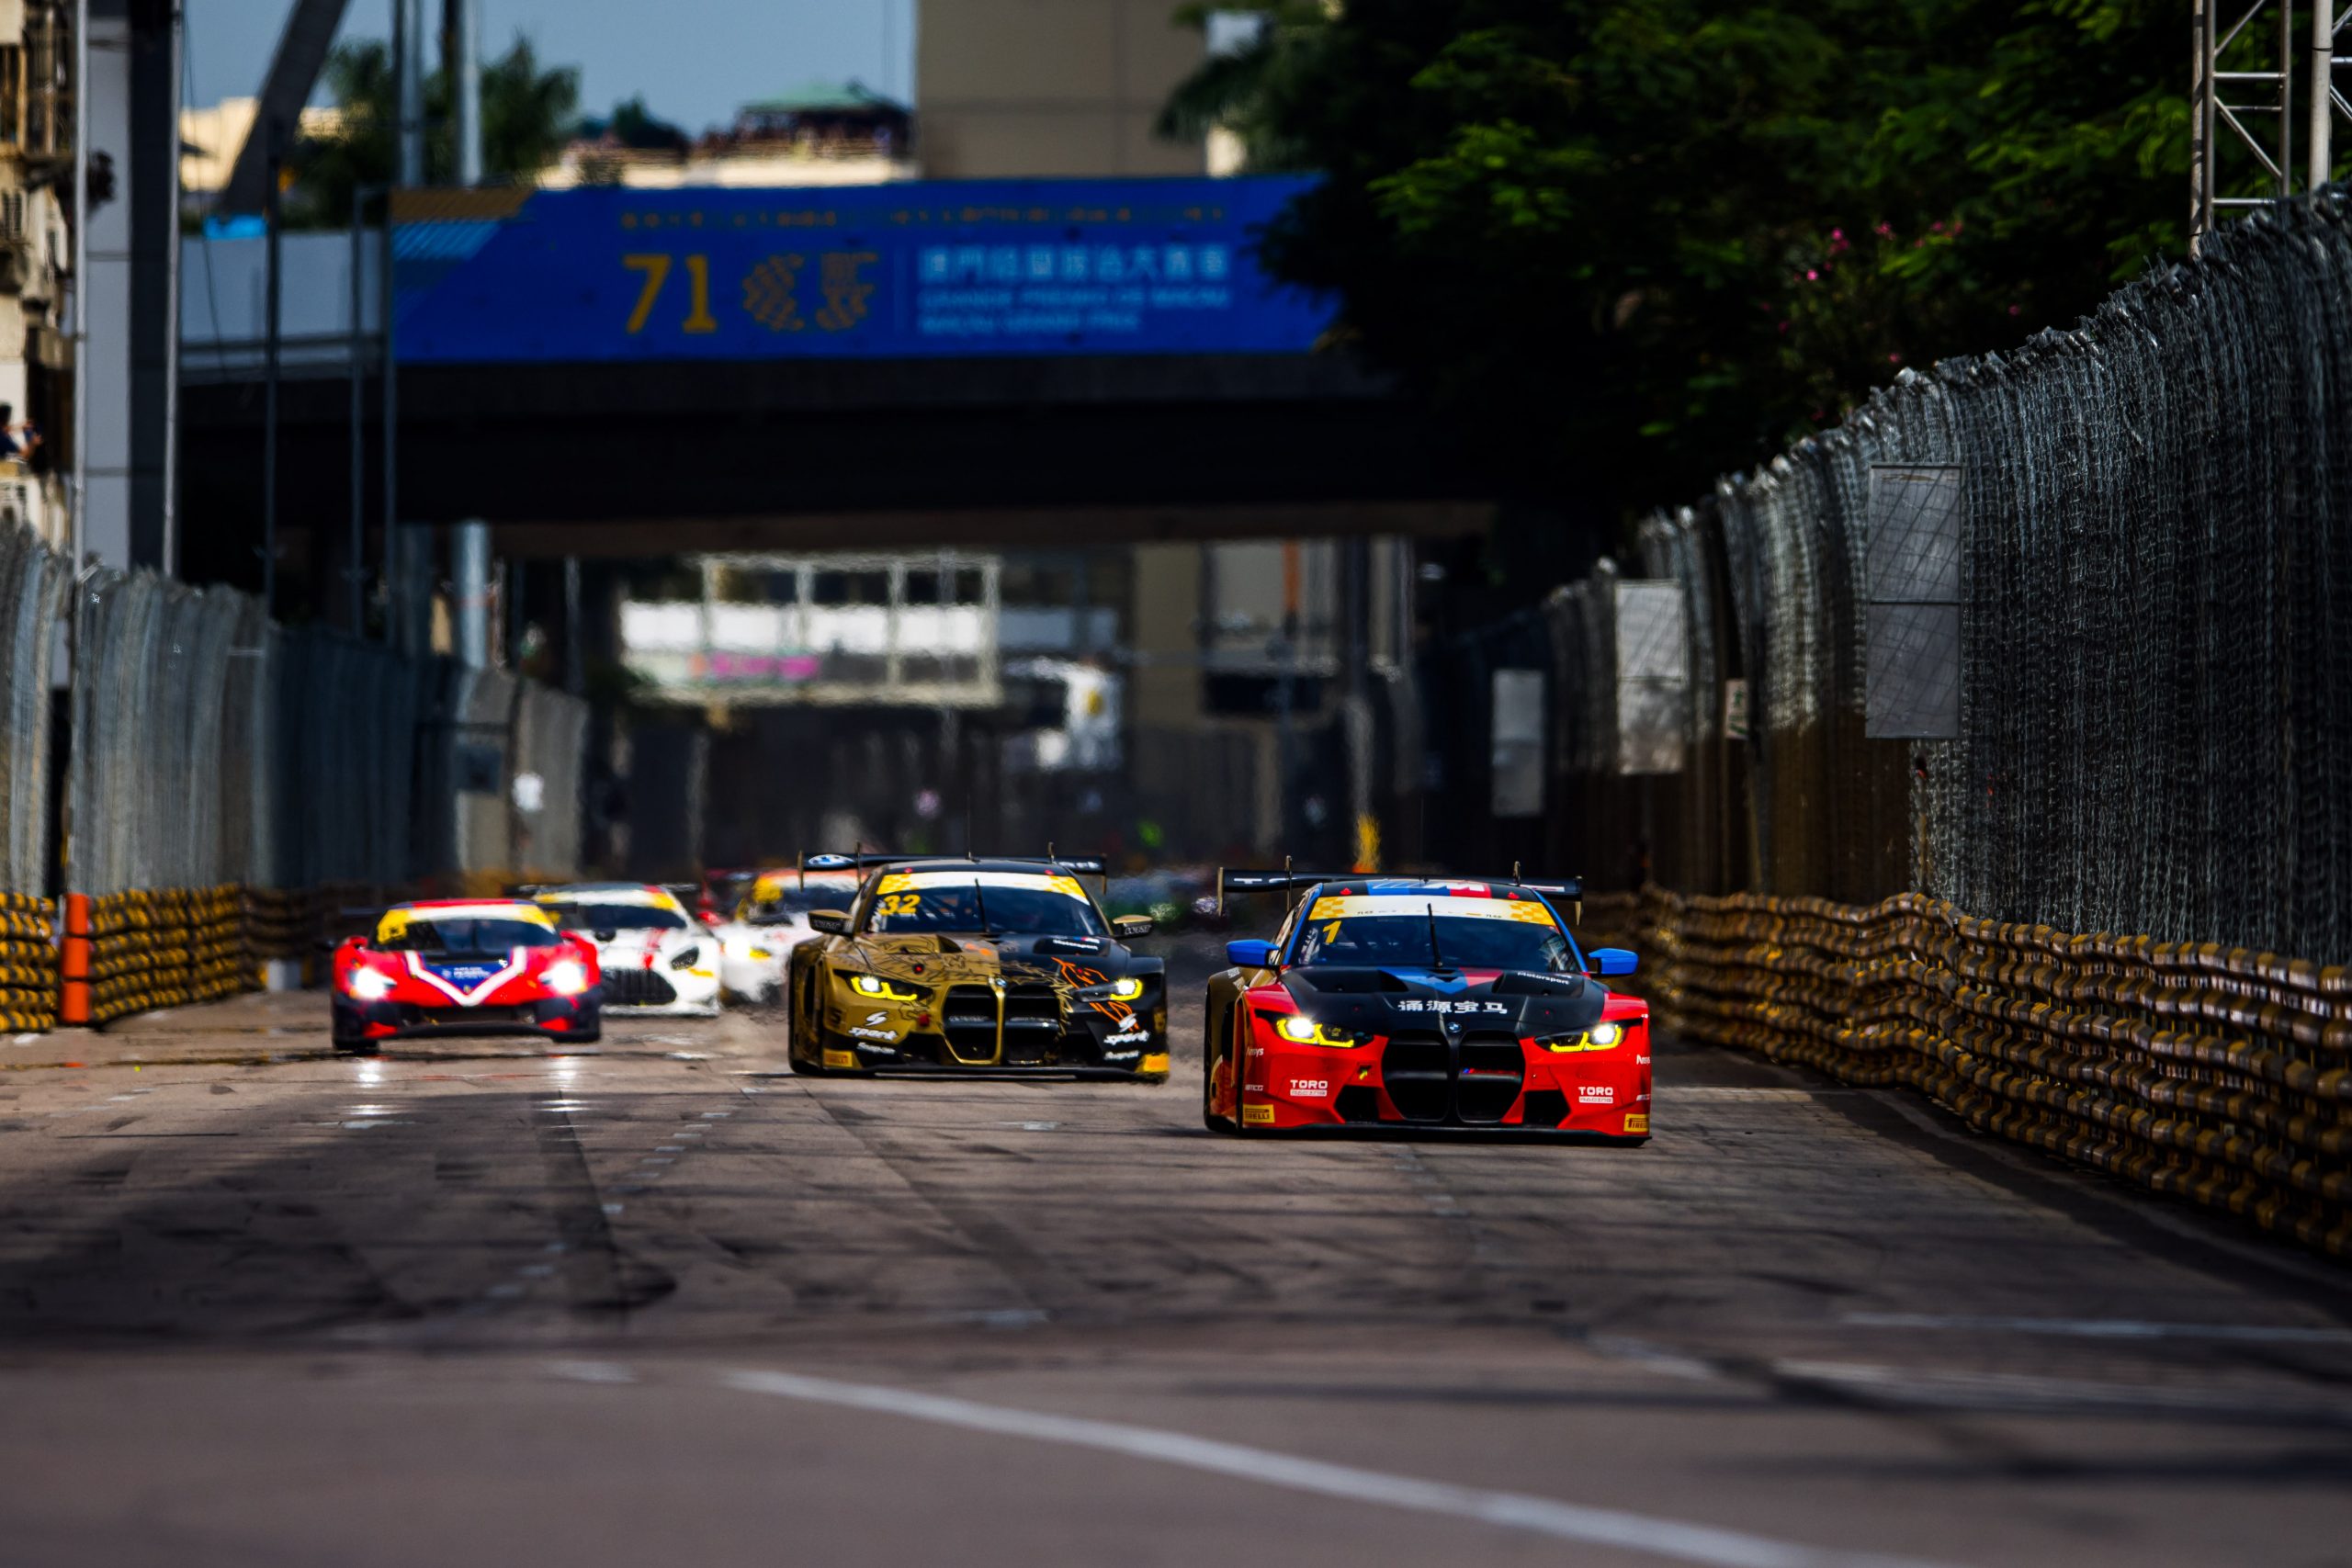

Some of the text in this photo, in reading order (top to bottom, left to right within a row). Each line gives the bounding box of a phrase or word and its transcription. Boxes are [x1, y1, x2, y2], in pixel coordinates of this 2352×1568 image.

[622, 253, 718, 334] 71
[877, 895, 922, 917] 32
[1322, 920, 1342, 943] 1
[1397, 999, 1508, 1014] 通源宝马
[848, 1027, 898, 1041] spark
[1290, 1079, 1329, 1089] TORO
[1577, 1087, 1614, 1096] TORO
